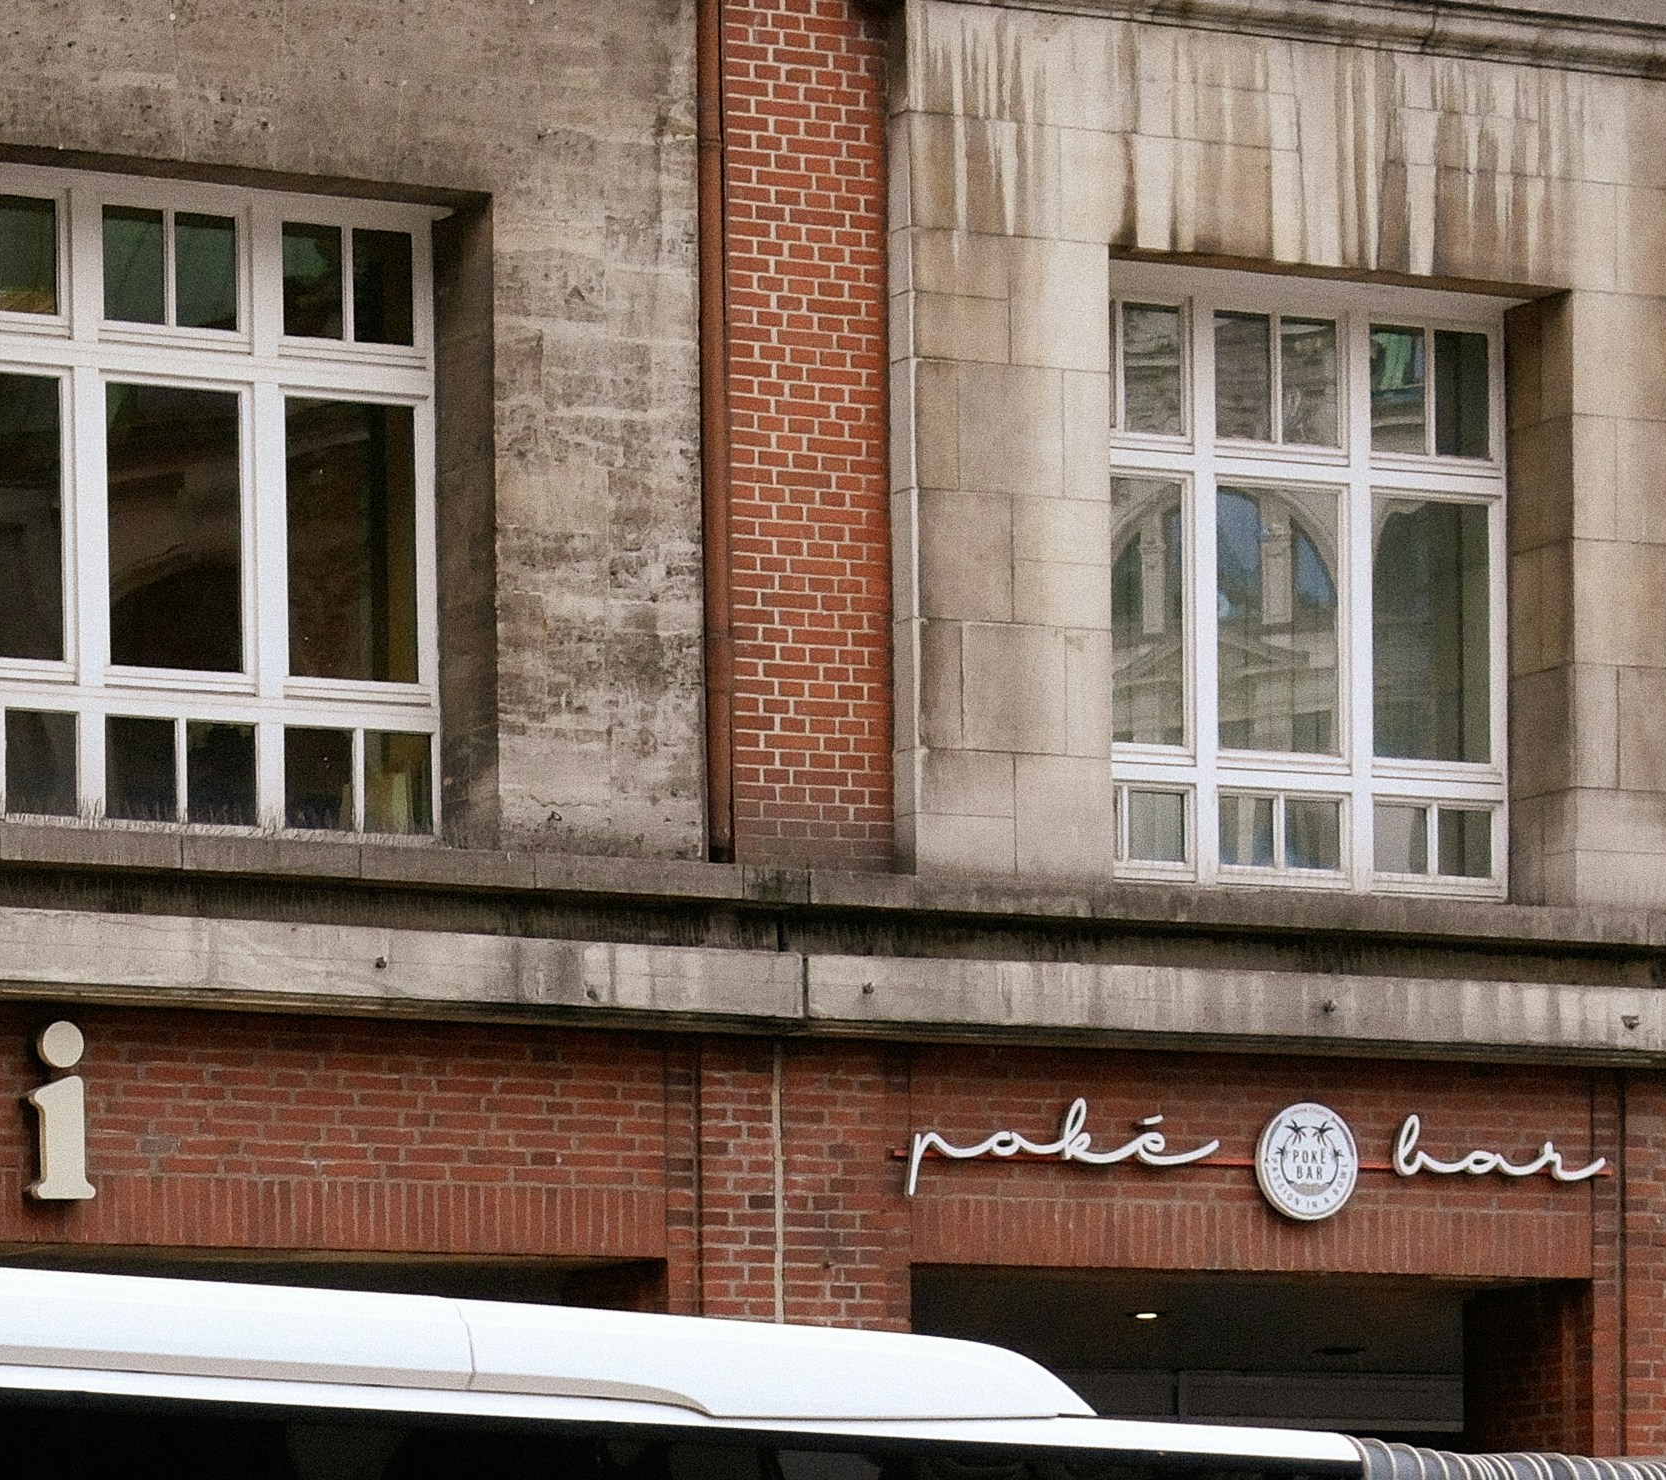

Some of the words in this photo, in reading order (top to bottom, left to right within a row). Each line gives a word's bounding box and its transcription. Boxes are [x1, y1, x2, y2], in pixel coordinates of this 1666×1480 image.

[905, 1097, 1220, 1197] poké
[1391, 1112, 1608, 1182] bar
[1295, 1166, 1323, 1180] BAR
